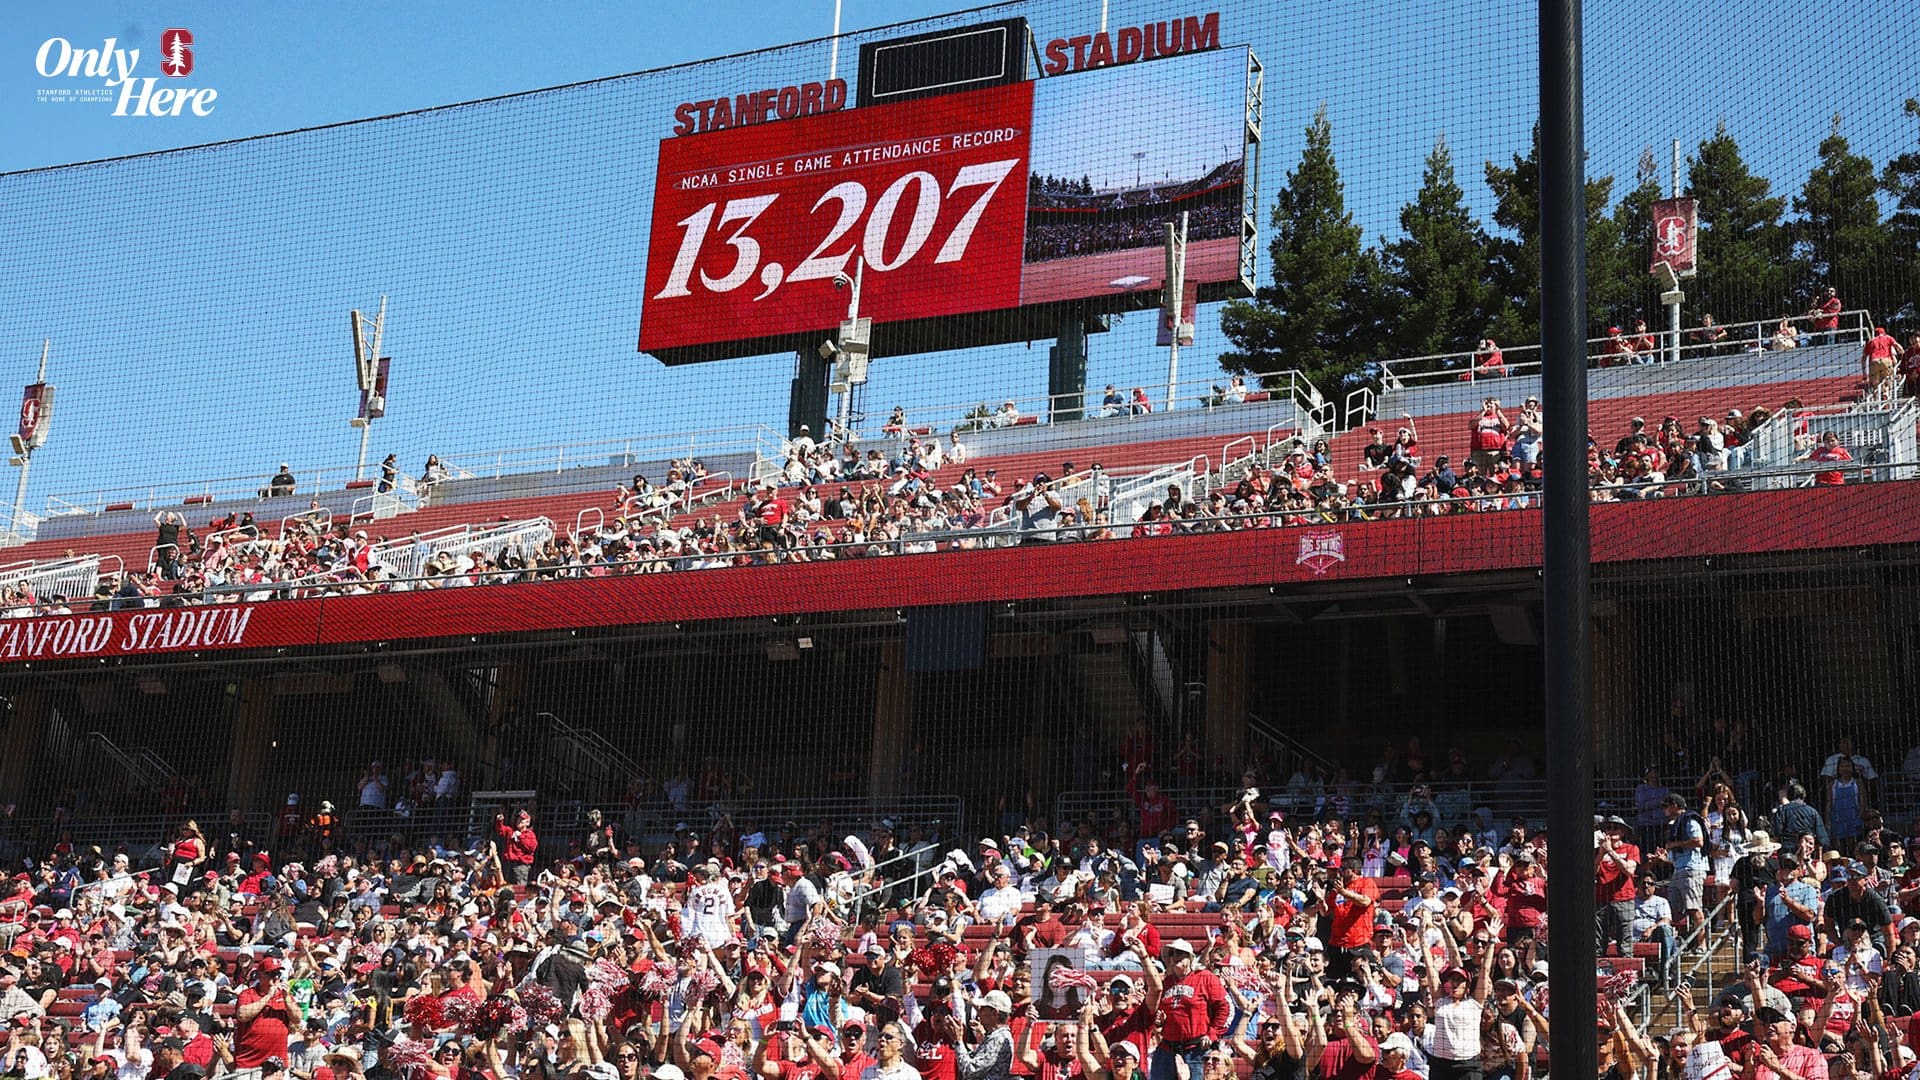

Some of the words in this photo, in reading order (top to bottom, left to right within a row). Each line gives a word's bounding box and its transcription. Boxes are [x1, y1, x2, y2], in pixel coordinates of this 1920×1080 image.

[1044, 12, 1219, 74] STADIUM
[673, 78, 847, 136] STANFORD
[681, 173, 718, 190] NCAA
[728, 163, 783, 184] SINGLE
[794, 155, 832, 173] GAME
[842, 138, 941, 165] ATTENDANCE
[952, 128, 1016, 149] RECORD
[653, 158, 1020, 302] 13,207
[121, 606, 255, 651] STADIUM
[703, 897, 714, 915] 2
